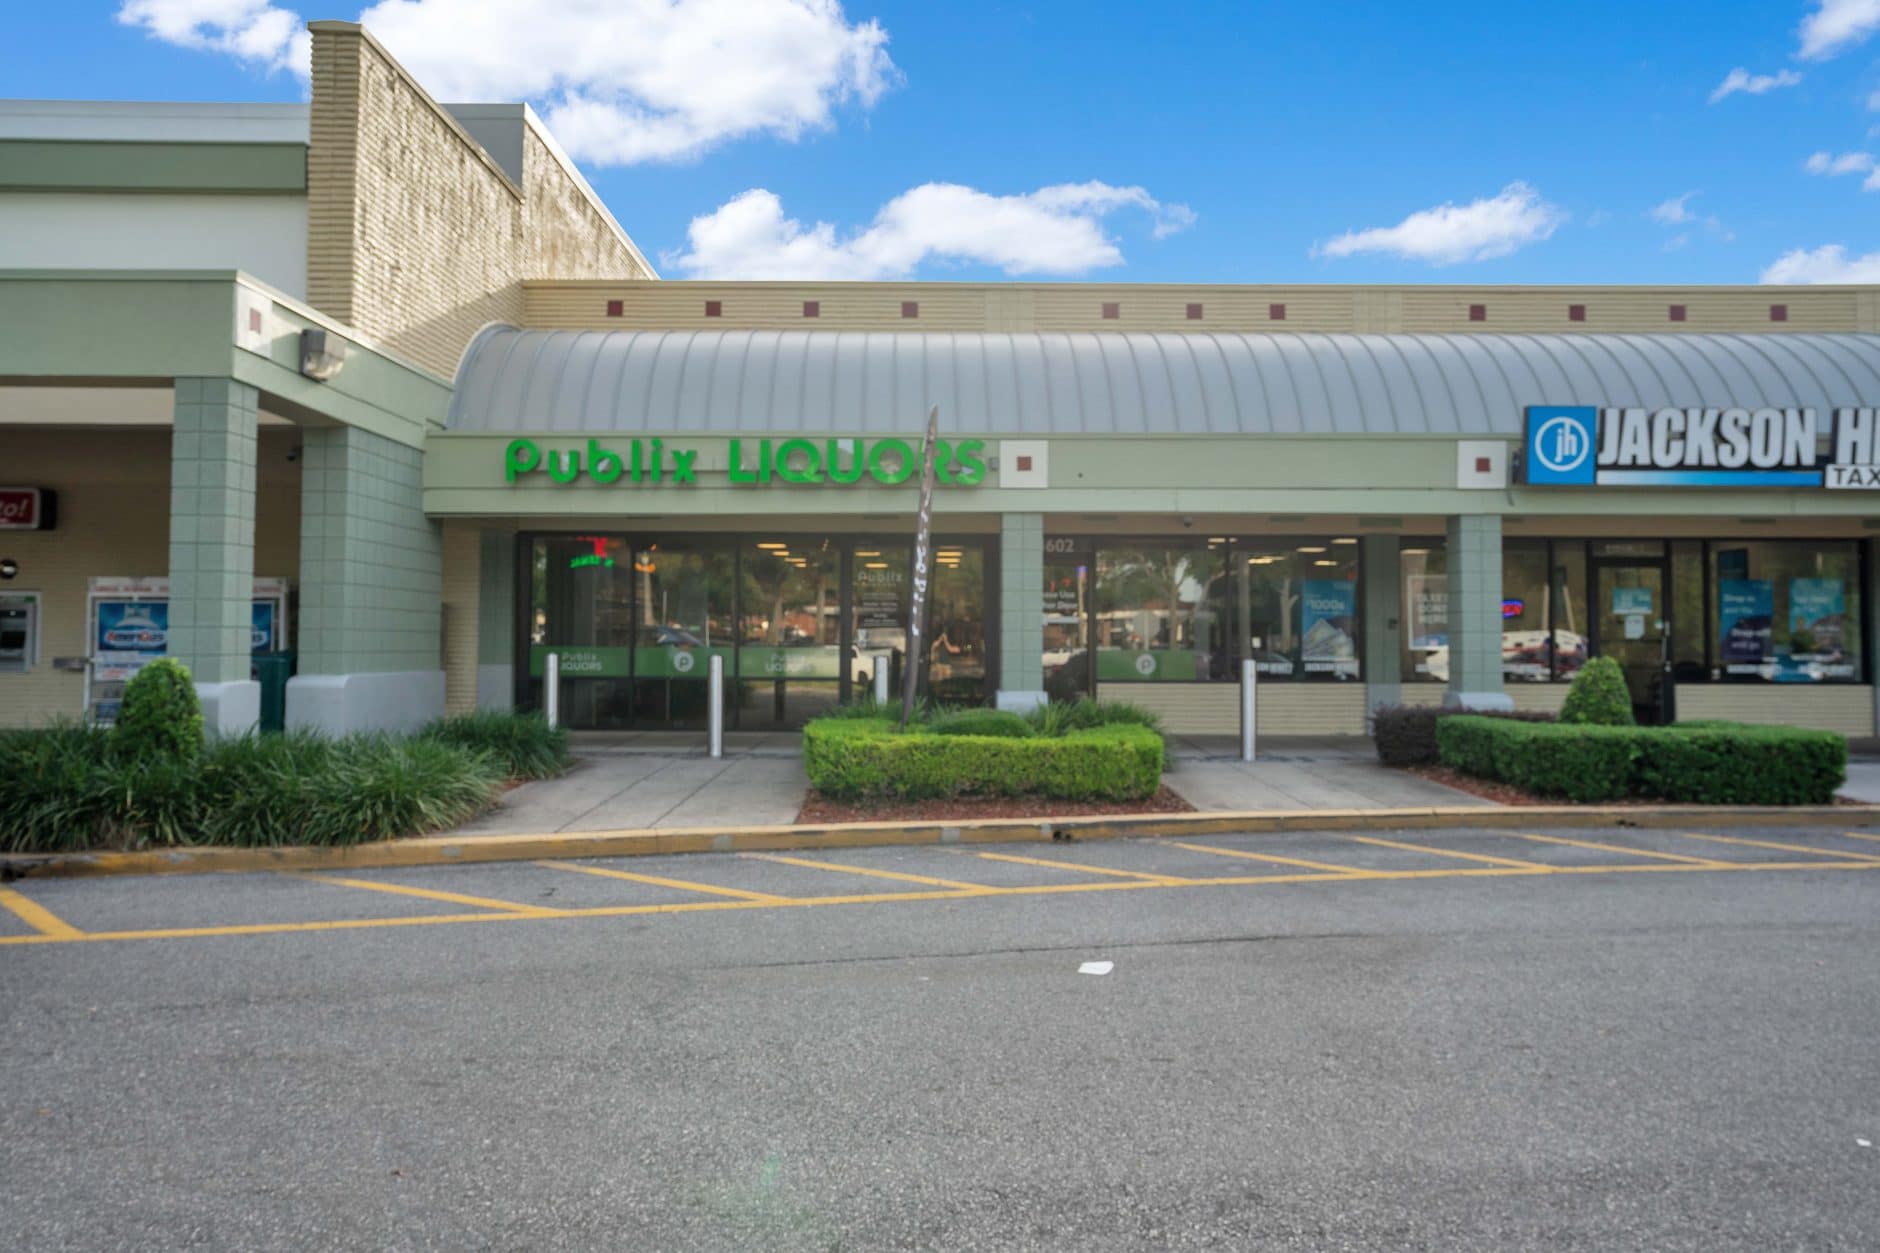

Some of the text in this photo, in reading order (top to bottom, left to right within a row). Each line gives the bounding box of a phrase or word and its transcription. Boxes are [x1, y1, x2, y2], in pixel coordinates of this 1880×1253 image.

[1597, 407, 1880, 468] JACKSON H
[506, 438, 986, 485] Publix LIQUORS
[1833, 468, 1880, 485] TAX
[1046, 539, 1074, 552] 602
